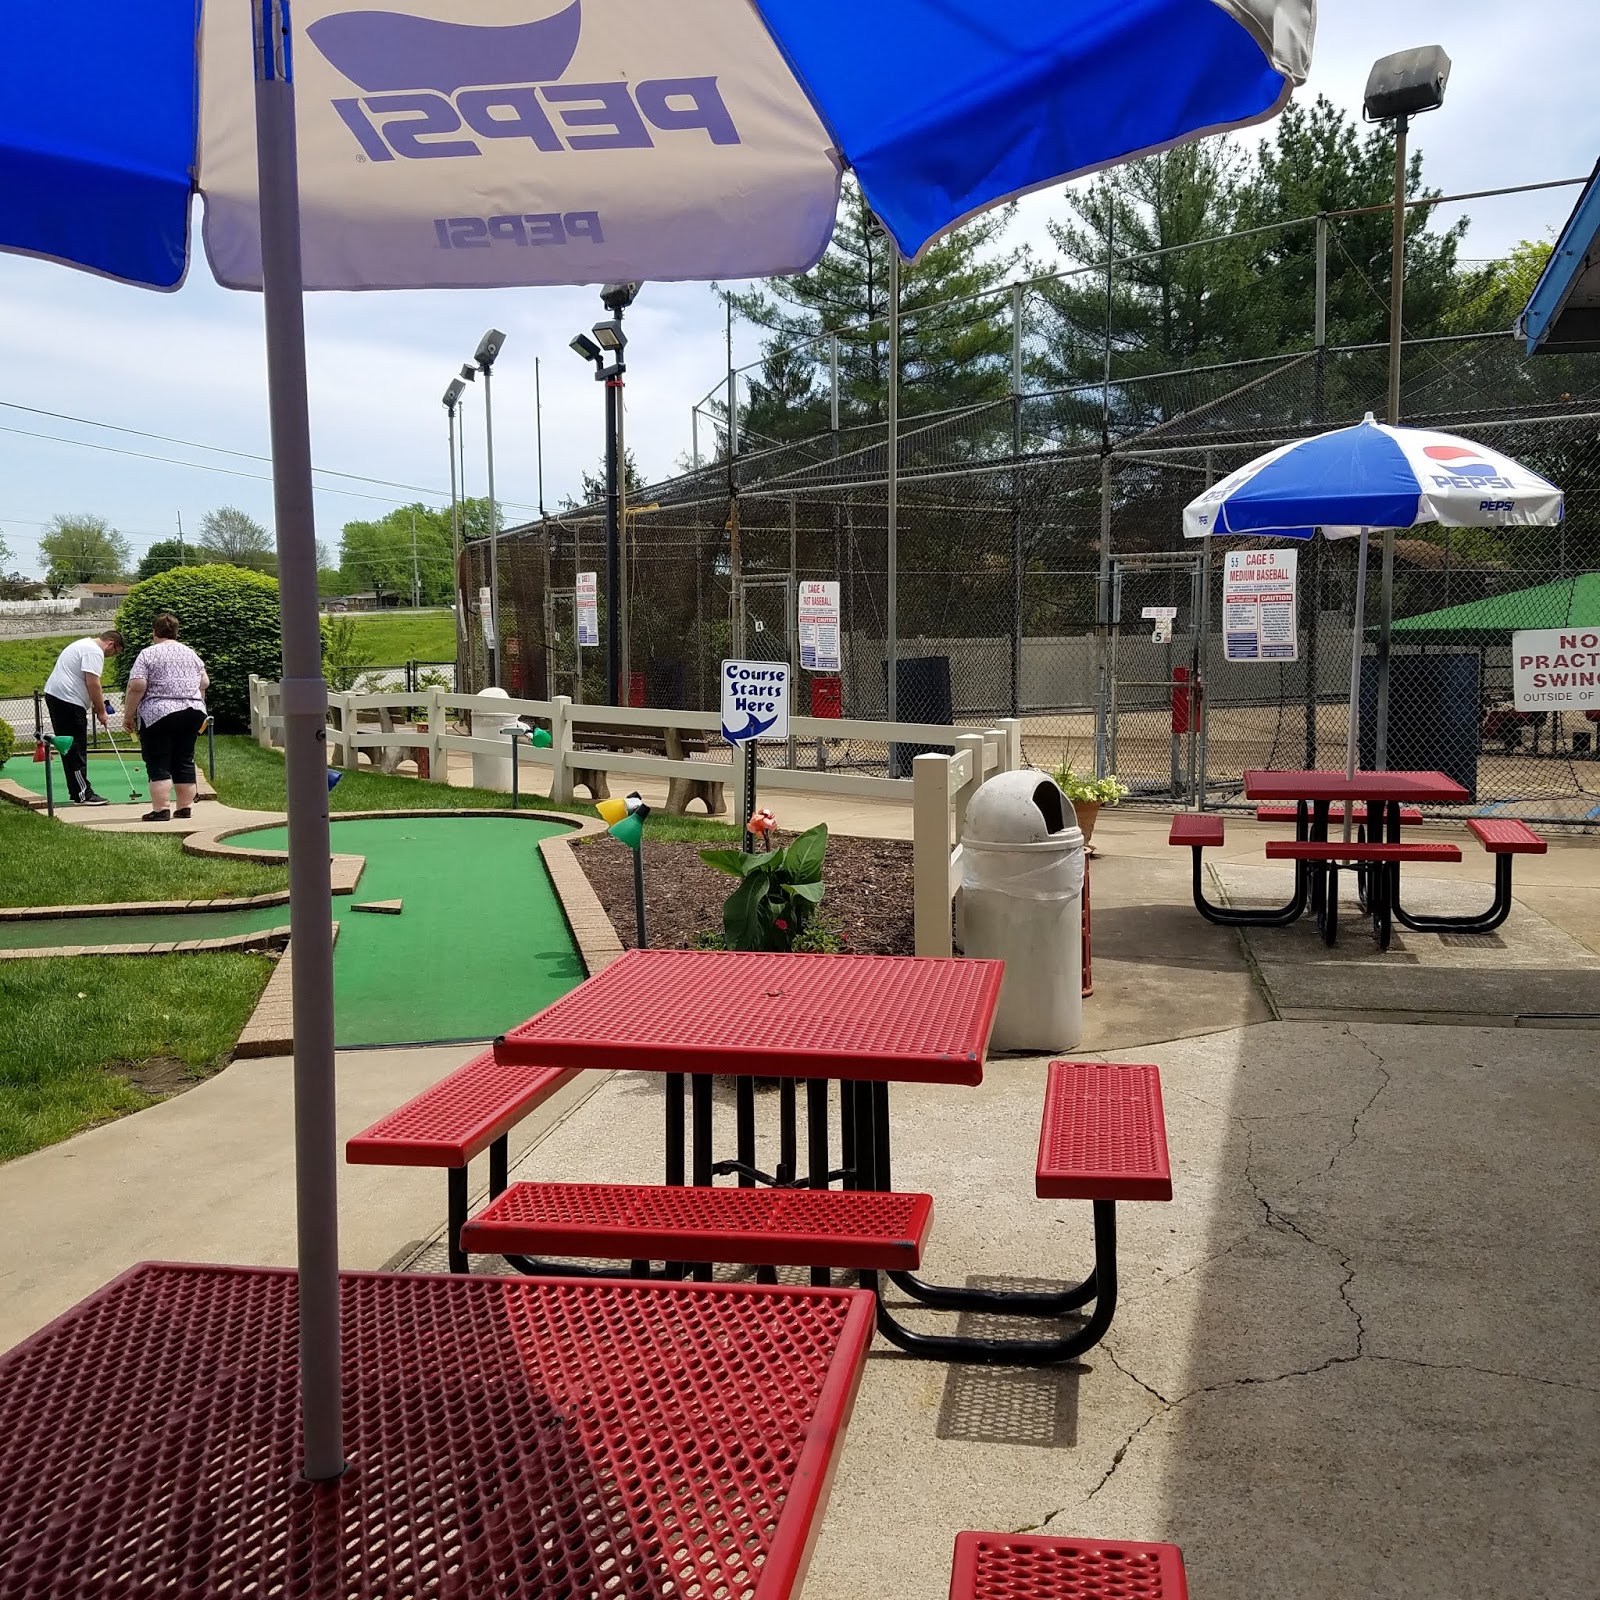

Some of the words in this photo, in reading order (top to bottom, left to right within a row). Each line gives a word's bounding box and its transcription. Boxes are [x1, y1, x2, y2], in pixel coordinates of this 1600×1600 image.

[1430, 475, 1516, 489] PEPSI
[1480, 501, 1515, 512] PEPSI
[1246, 554, 1267, 566] CAGE
[1269, 553, 1275, 564] 5
[1230, 570, 1254, 581] MEDIUM
[1256, 568, 1289, 581] BASEBALL
[808, 585, 820, 594] CAGE
[822, 585, 825, 594] 4
[812, 597, 832, 606] BASEBALL
[1155, 632, 1162, 641] 5
[1560, 634, 1598, 649] NO
[1520, 653, 1600, 669] PRACT
[726, 665, 785, 681] Course
[1533, 672, 1600, 688] SWIN
[729, 682, 781, 697] Starts
[1523, 692, 1573, 701] OUTSIDE
[1579, 691, 1595, 700] OF
[736, 698, 775, 712] Here
